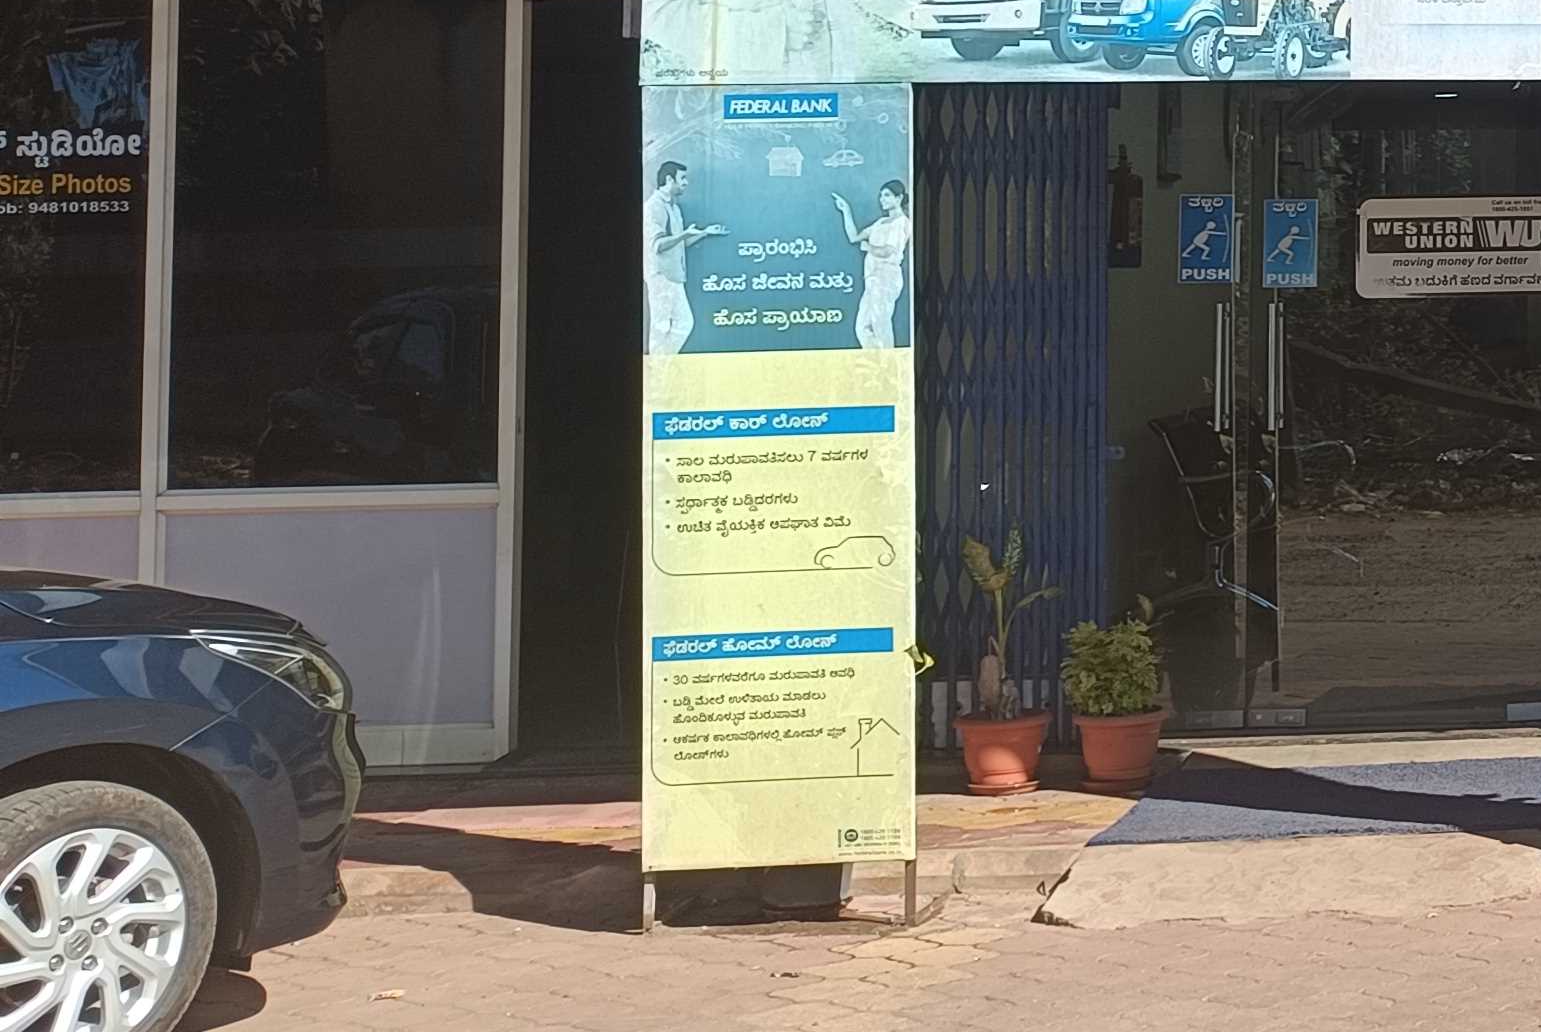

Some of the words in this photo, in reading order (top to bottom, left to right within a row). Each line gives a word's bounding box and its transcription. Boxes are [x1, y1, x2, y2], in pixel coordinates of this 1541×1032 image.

[729, 98, 788, 114] FEDERAL
[791, 98, 832, 113] BANK
[16, 127, 142, 168] ಸ್ಟುಡಿಯೋ
[52, 173, 131, 194] Photos
[28, 201, 130, 213] 9481018533
[1372, 221, 1474, 236] WESTERN
[1404, 234, 1474, 248] UNION
[738, 238, 817, 263] ಪ್ರಾರಂಭಿಸಿ
[1392, 257, 1433, 268] moving
[1436, 256, 1473, 268] money
[1477, 255, 1493, 265] for
[1495, 255, 1528, 265] better
[702, 273, 746, 292] ಹೊಸ
[752, 272, 804, 291] ಜೀವನ
[809, 271, 854, 293] ಮತ್ತು
[1181, 268, 1230, 280] PUSH
[1266, 273, 1314, 285] PUSH
[713, 308, 758, 327] ಹೊಸ
[664, 414, 724, 436] ಫೆಡರಲ್
[729, 413, 768, 431] ಕಾರ್
[676, 454, 704, 468] ಸಾಲ
[808, 450, 817, 462] 7
